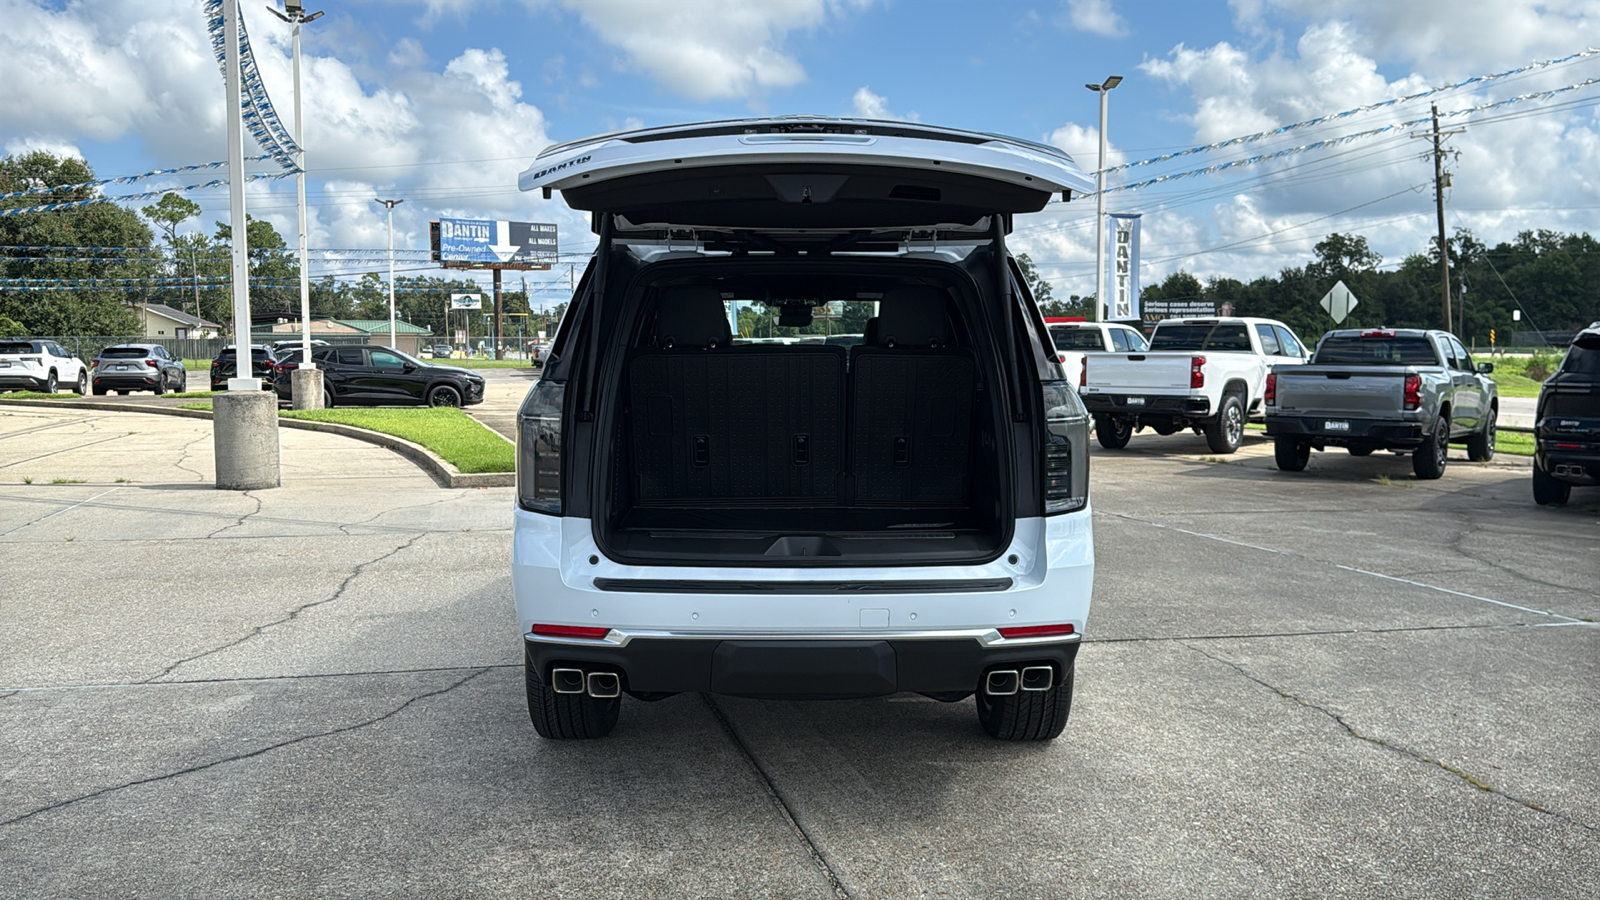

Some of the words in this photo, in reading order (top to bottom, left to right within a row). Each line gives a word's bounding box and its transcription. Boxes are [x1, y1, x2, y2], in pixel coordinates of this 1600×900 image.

[533, 155, 592, 180] DANTIN
[441, 220, 490, 238] DANTIN
[540, 225, 556, 233] MAKES
[442, 244, 486, 252] Pre-Owned
[1116, 231, 1129, 316] DANTIN
[1324, 421, 1350, 430] DANTIN
